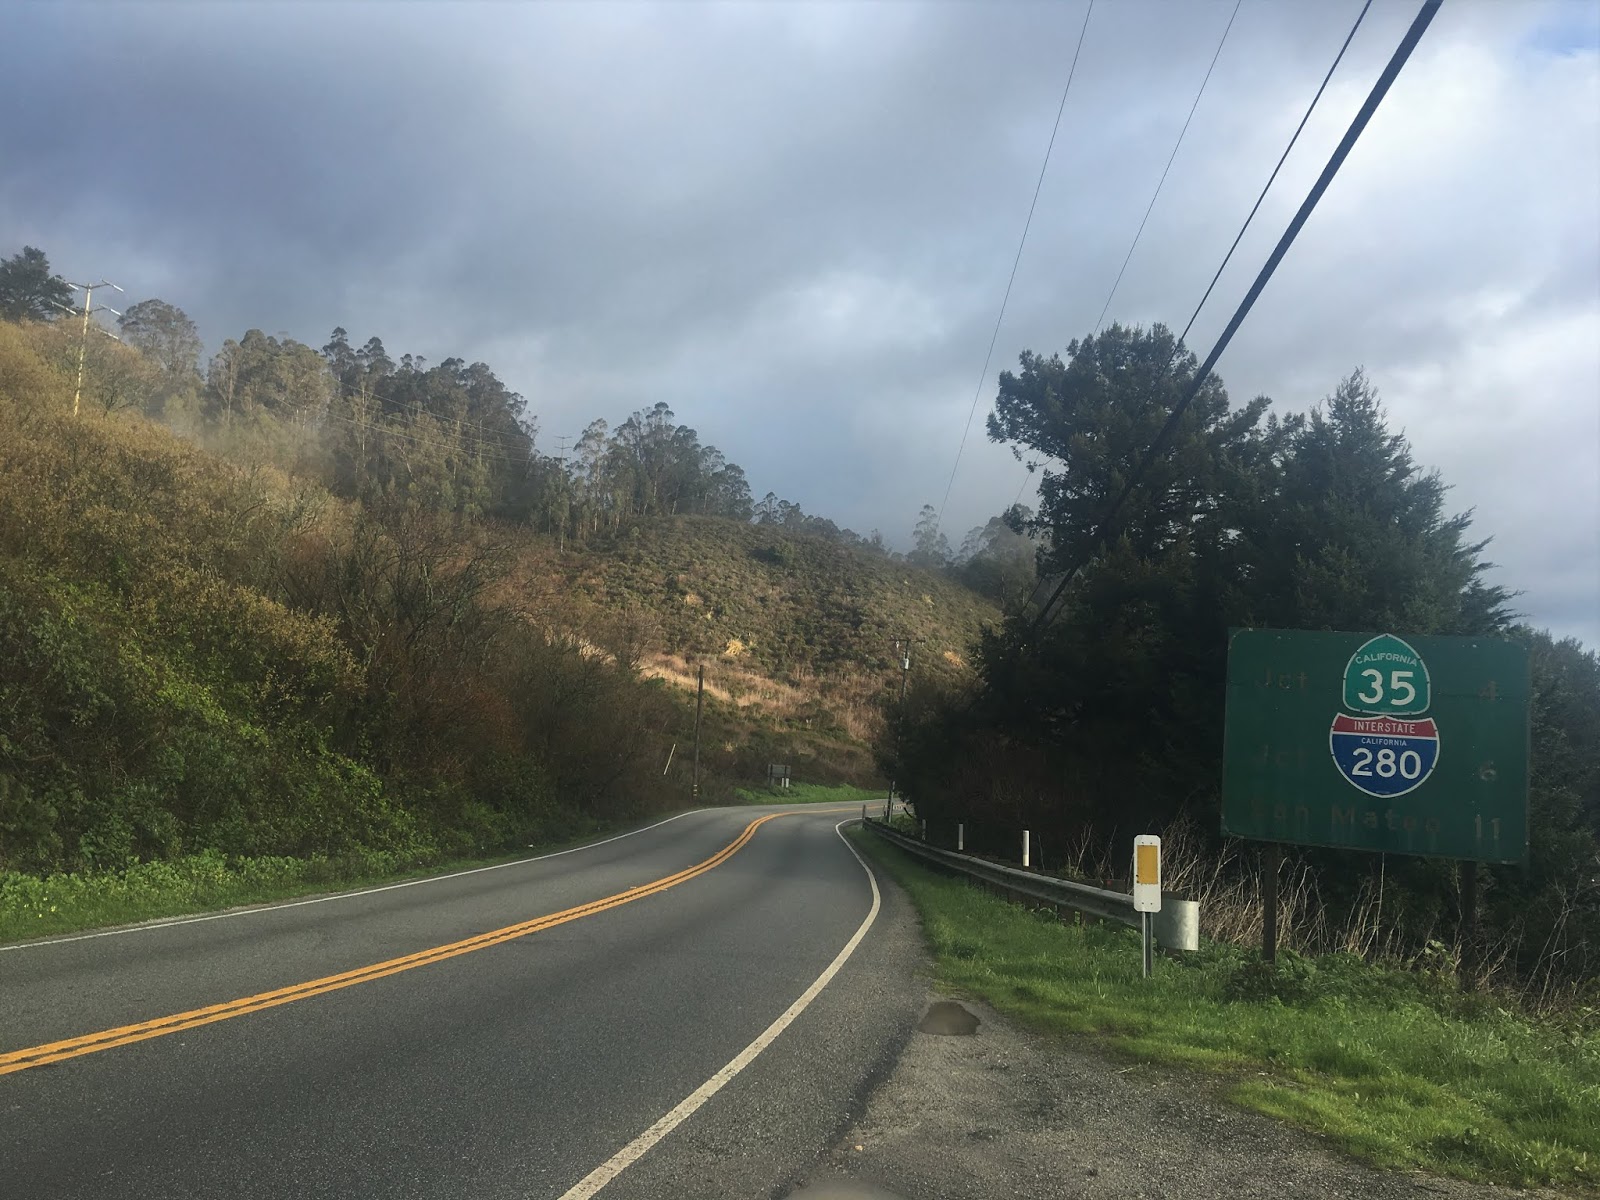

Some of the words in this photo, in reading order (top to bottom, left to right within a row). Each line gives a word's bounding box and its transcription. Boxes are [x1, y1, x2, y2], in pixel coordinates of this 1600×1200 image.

[1355, 653, 1417, 667] CALIFORNIA
[1255, 667, 1308, 690] Jct
[1358, 669, 1416, 705] 35
[1478, 680, 1497, 701] 4
[1354, 721, 1415, 733] INTERSTATE
[1361, 738, 1407, 746] CALIFORNIA
[1352, 748, 1421, 779] 280
[1479, 759, 1498, 781] 6
[1331, 804, 1440, 833] Mateo
[1475, 814, 1500, 840] 11
